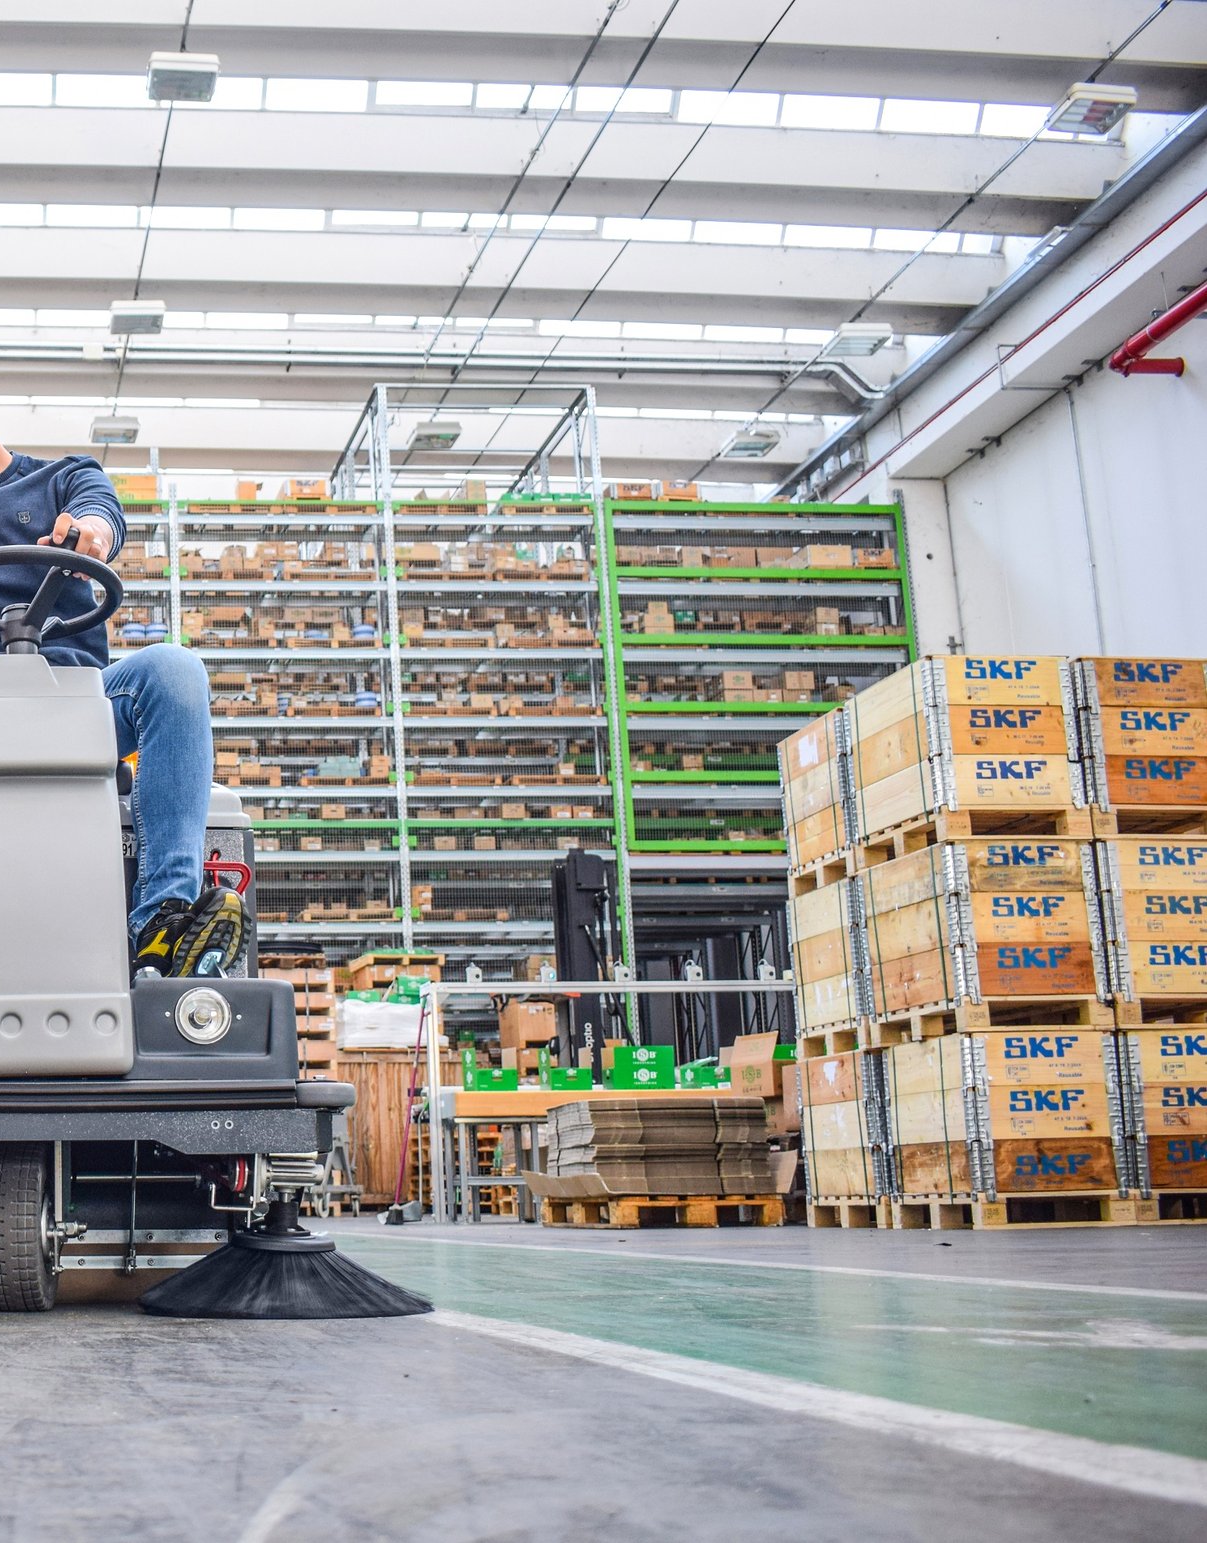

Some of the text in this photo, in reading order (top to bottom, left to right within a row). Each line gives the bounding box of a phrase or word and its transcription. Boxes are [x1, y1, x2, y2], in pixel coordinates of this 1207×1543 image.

[965, 658, 1037, 679] SKF
[1113, 662, 1183, 683] SKF
[969, 709, 1042, 729] SKF
[1120, 711, 1191, 731] SKF
[976, 760, 1047, 780] SKF
[1125, 759, 1196, 780] SKF
[987, 845, 1060, 866] SKF
[1138, 846, 1207, 866] SKF
[992, 896, 1065, 917] SKF
[997, 947, 1072, 969] SKF
[1004, 1036, 1079, 1059] SKF
[1160, 1035, 1207, 1057] SK
[1009, 1089, 1085, 1112] SKF
[1161, 1087, 1207, 1107] SK
[1167, 1139, 1207, 1162] SK
[1014, 1154, 1092, 1176] SKF
